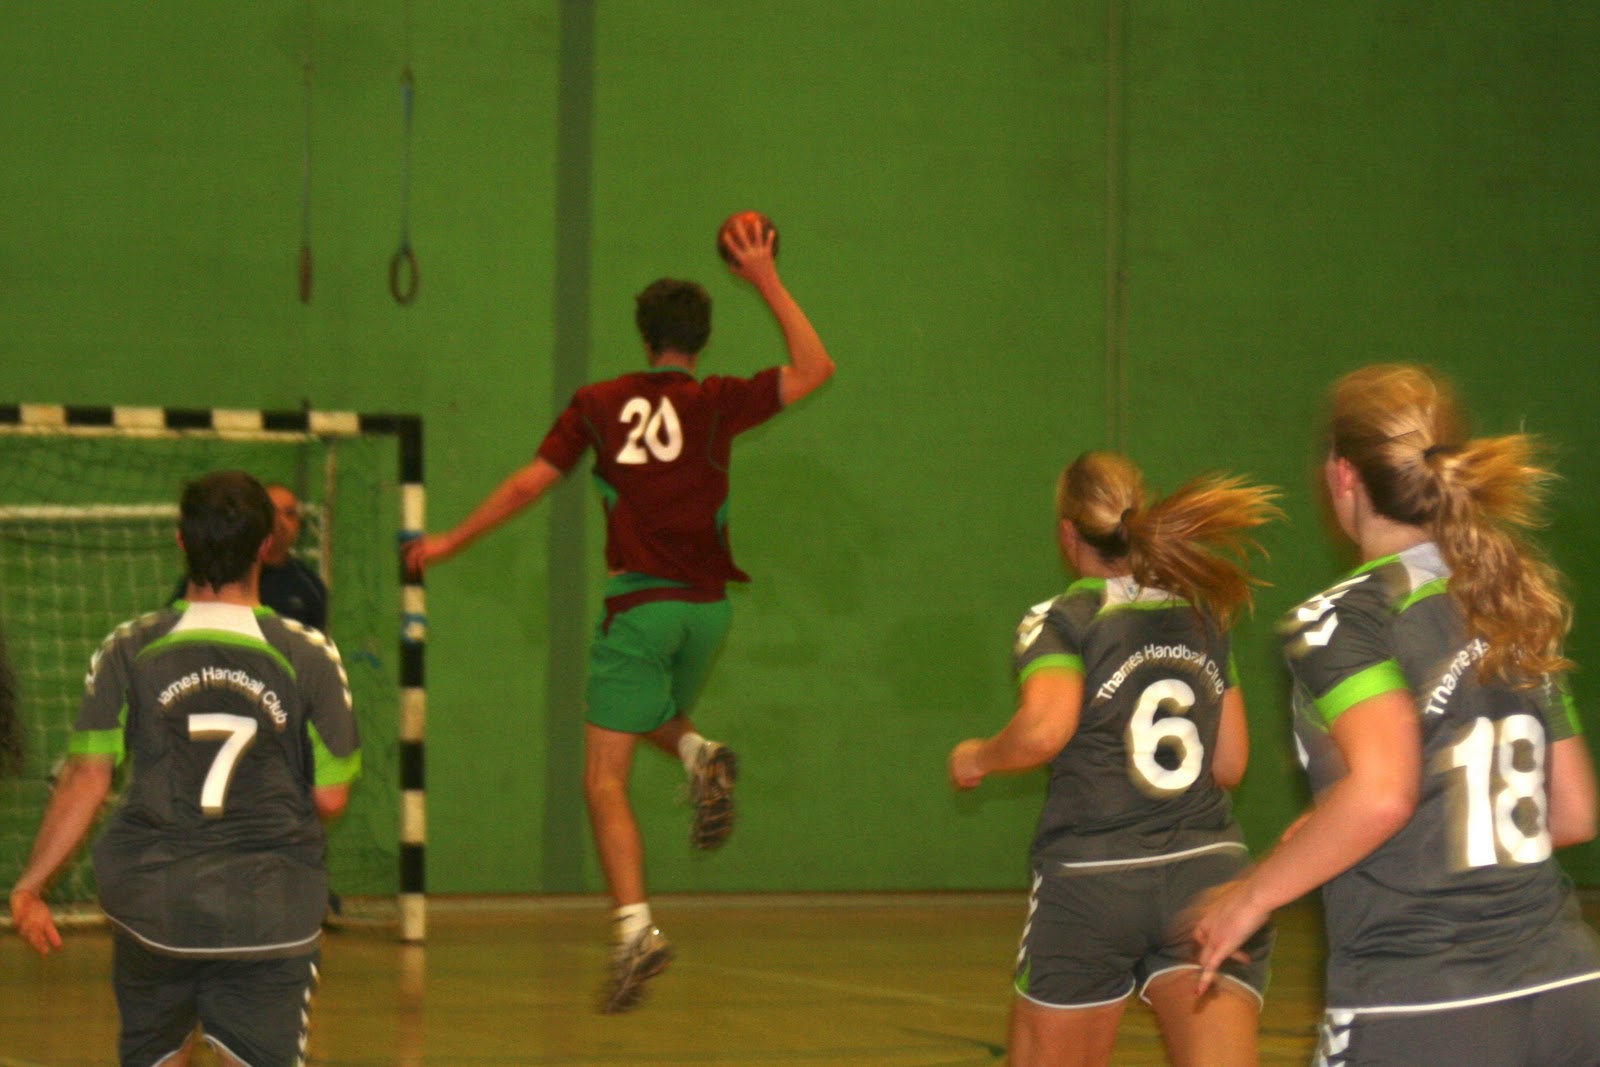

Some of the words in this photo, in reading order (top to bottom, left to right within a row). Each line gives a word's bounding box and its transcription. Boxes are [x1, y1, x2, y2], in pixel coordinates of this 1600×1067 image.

[616, 396, 683, 464] 20
[202, 666, 265, 695] Handball
[262, 691, 288, 724] Club
[1096, 651, 1144, 700] Thames
[1144, 643, 1207, 667] Handball
[1205, 660, 1225, 695] Club
[187, 712, 258, 808] 7
[1130, 678, 1205, 791] 6
[1452, 713, 1553, 868] 18
